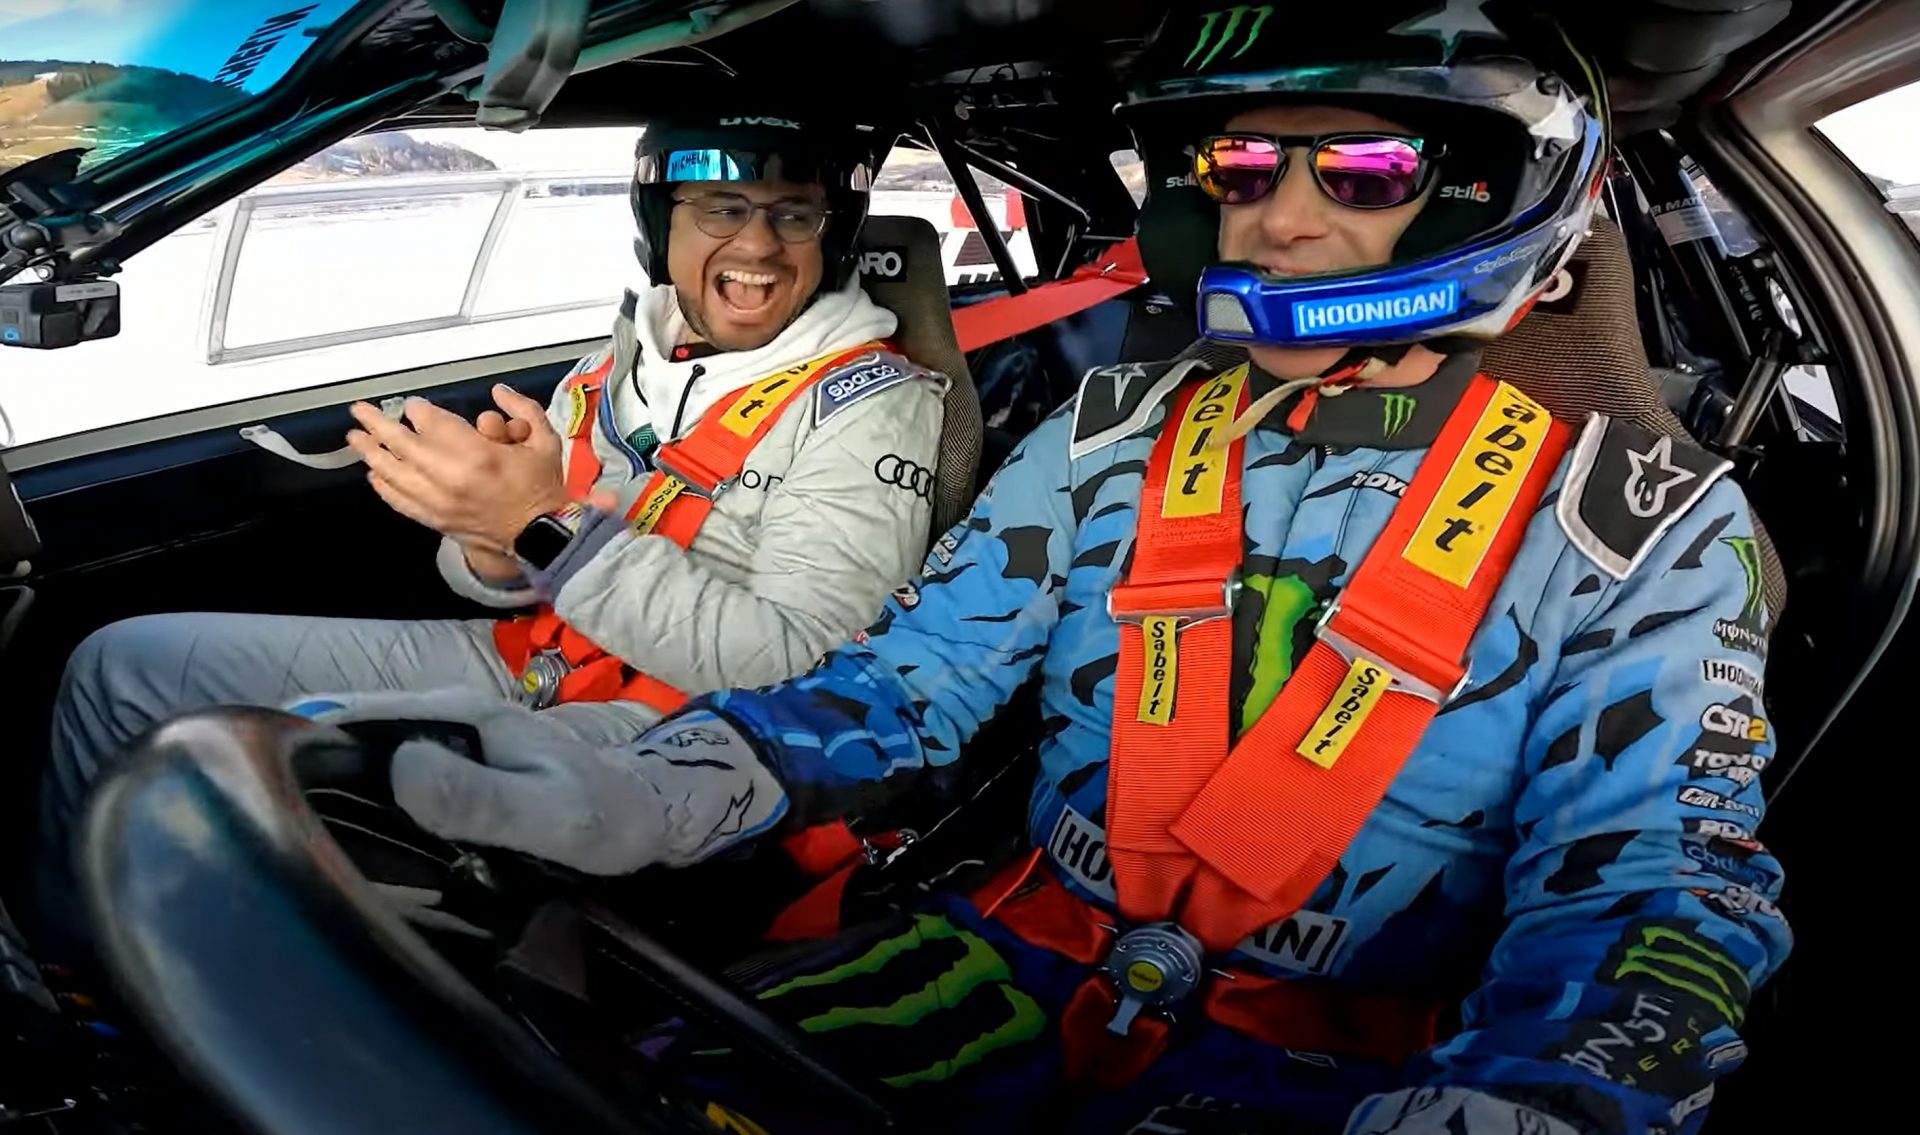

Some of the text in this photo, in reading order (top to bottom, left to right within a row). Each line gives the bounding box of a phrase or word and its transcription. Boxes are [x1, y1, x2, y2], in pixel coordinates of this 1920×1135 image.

[635, 479, 681, 532] Sabelt
[1149, 621, 1165, 716] Sabelt
[1314, 667, 1381, 755] Sabelt
[1701, 704, 1767, 742] CSR2
